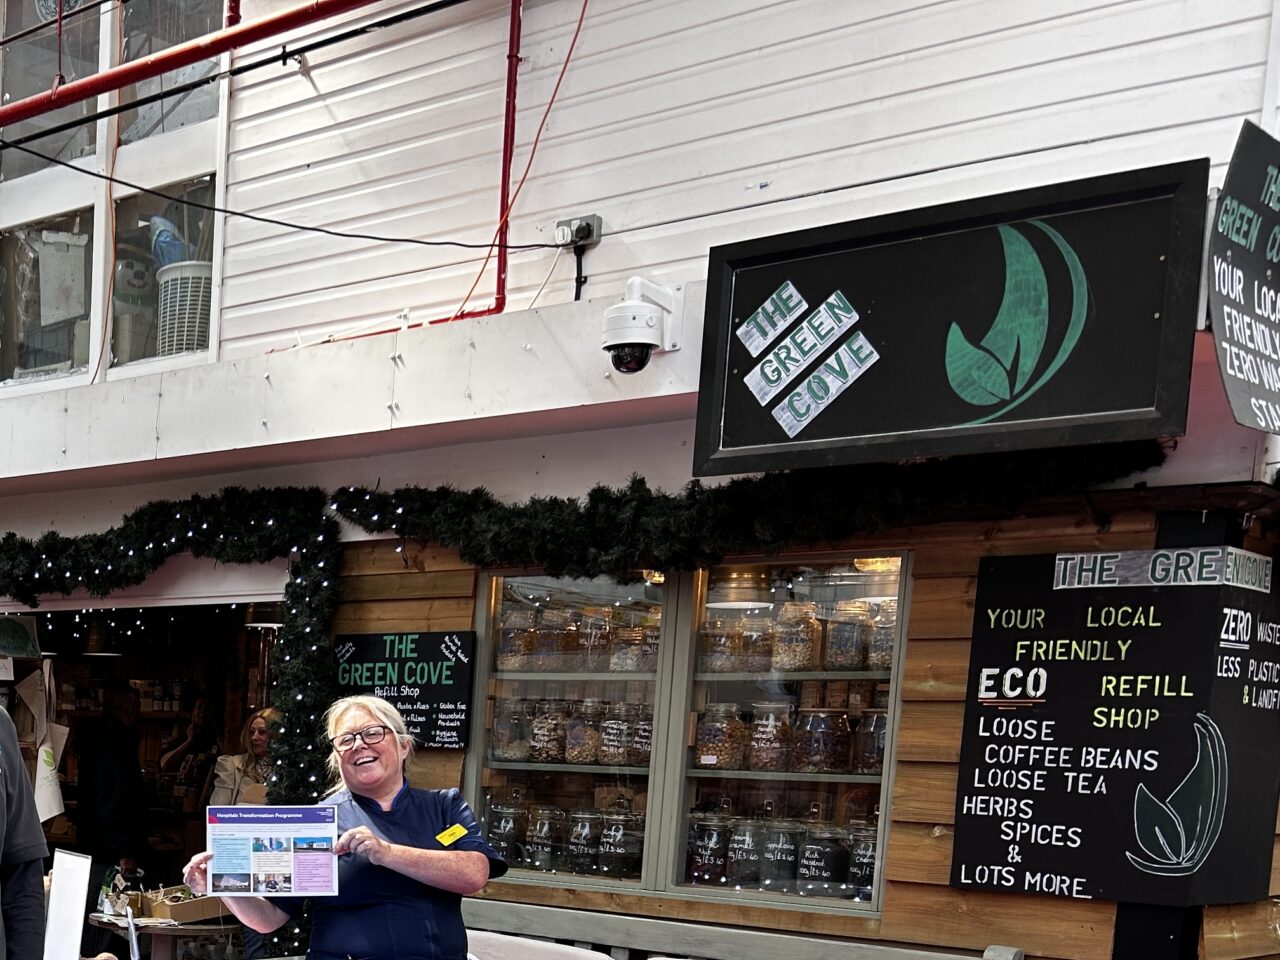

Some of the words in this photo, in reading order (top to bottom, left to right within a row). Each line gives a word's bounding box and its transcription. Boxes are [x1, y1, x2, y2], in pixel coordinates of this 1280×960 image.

[1217, 195, 1262, 253] GREEN
[1214, 255, 1244, 305] YOUR
[746, 282, 803, 340] THE
[760, 292, 853, 387] GREEN
[1222, 341, 1259, 384] ZERO
[788, 332, 874, 422] COVE
[1057, 555, 1120, 586] THE
[1245, 557, 1270, 590] COVE
[987, 608, 1046, 629] YOUR
[1086, 606, 1161, 628] LOCAL
[1220, 608, 1252, 642] ZERO
[383, 634, 419, 658] THE
[1015, 639, 1131, 662] FRIENDLY
[339, 662, 398, 686] GREEN
[404, 661, 454, 685] COVE
[1217, 656, 1241, 677] LESS
[375, 686, 398, 698] Refill
[400, 685, 420, 699] Shop
[979, 667, 1048, 699] ECO
[1101, 675, 1194, 698] REFILL
[1243, 685, 1249, 704] &
[438, 712, 466, 720] Household
[978, 716, 1056, 741] LOOSE
[1093, 707, 1160, 729] SHOP
[985, 744, 1072, 768] COFFEE
[1081, 747, 1159, 772] BEANS
[974, 769, 1047, 792] LOOSE
[1064, 773, 1107, 795] TEA
[963, 796, 1034, 819] HERBS
[1000, 821, 1082, 848] SPICES
[1007, 845, 1022, 864] &
[961, 864, 1016, 887] LOTS
[1024, 873, 1092, 900] MORE
